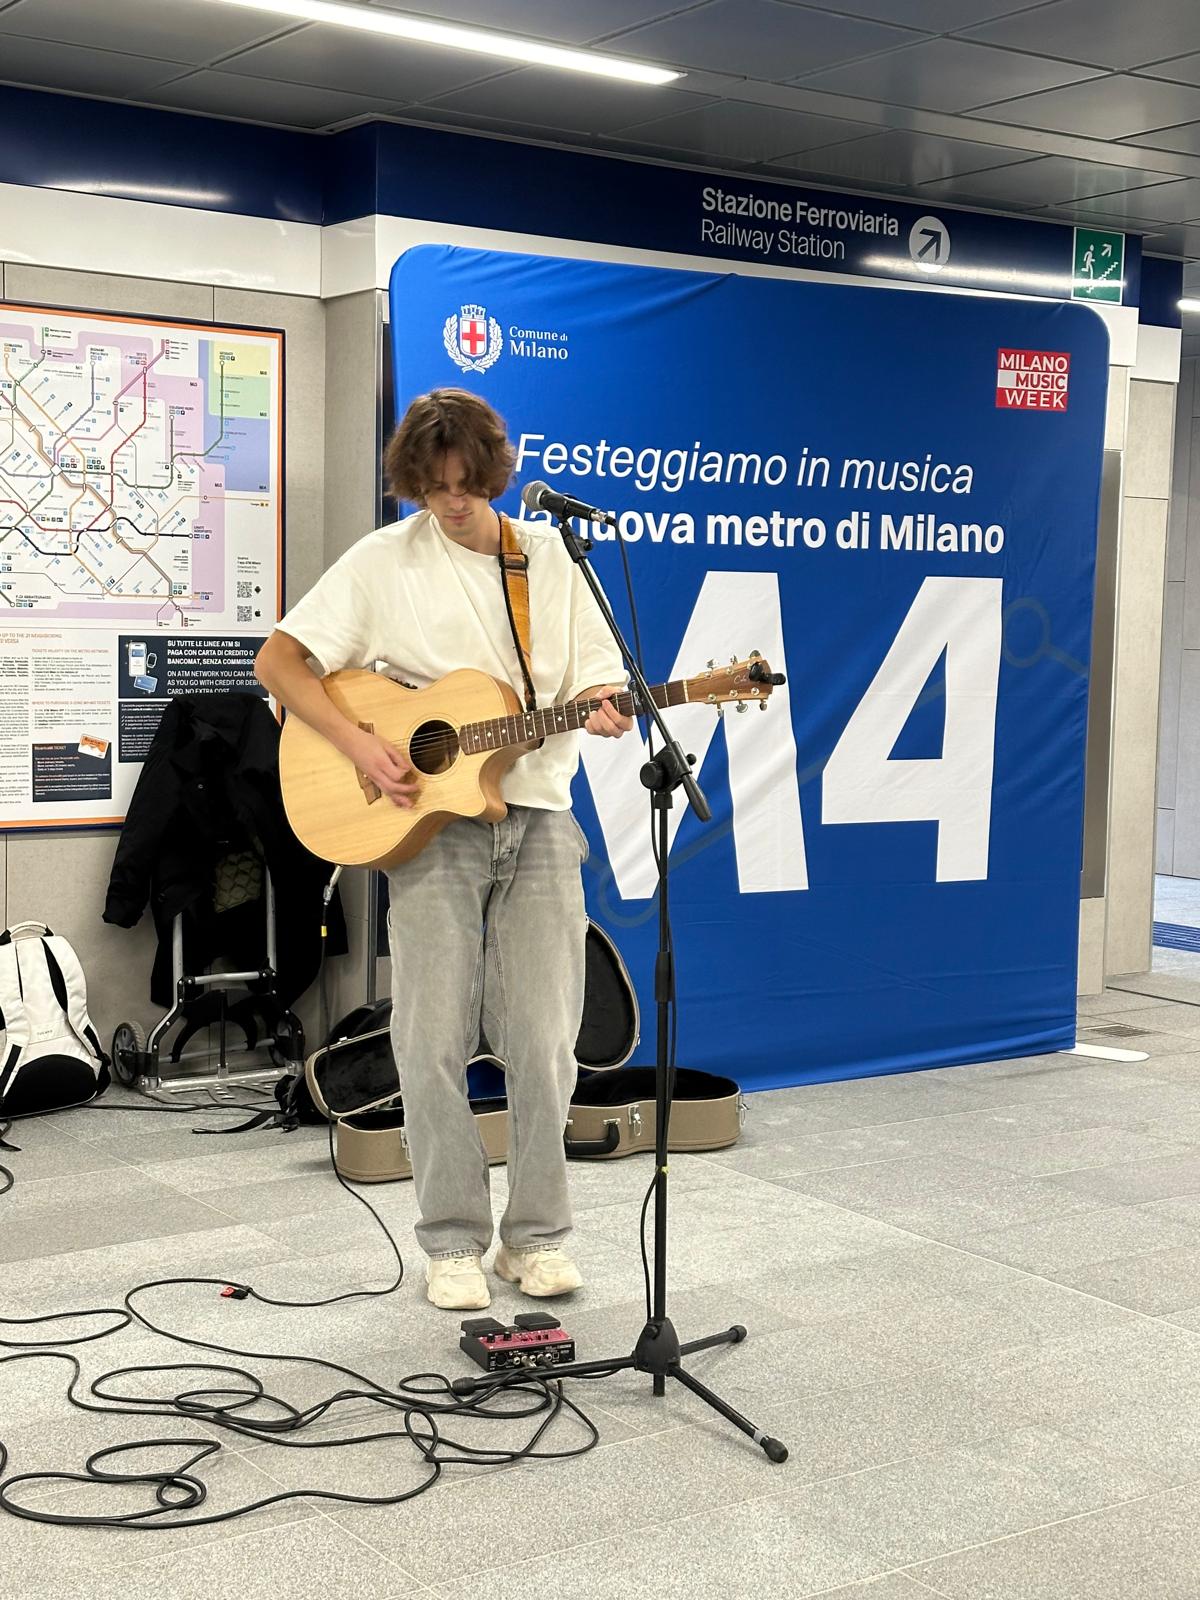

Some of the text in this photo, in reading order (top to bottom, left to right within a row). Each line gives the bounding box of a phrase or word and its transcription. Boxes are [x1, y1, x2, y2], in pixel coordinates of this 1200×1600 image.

[702, 187, 899, 236] Stazione Ferroviaria
[701, 218, 845, 259] Railway Station
[509, 325, 569, 341] Comune di
[510, 340, 569, 361] Milano
[1000, 353, 1068, 372] MILANO
[1015, 372, 1066, 390] MUSIC
[1005, 390, 1065, 409] WEEK
[515, 433, 974, 494] Festeggiamo in musica
[706, 513, 827, 549] metro
[836, 512, 870, 550] di
[880, 514, 1005, 555] Milano
[579, 570, 1005, 902] M4
